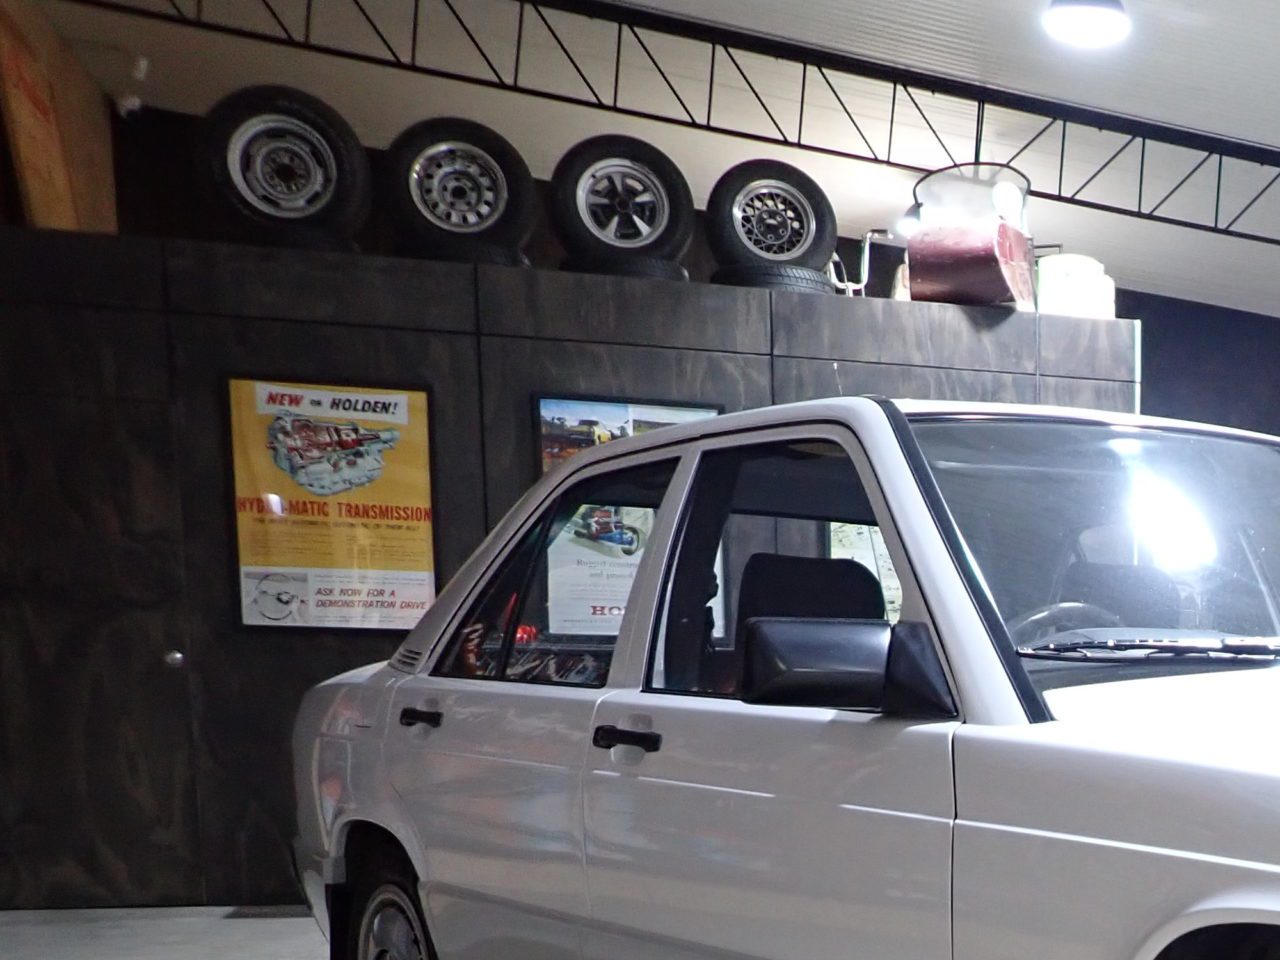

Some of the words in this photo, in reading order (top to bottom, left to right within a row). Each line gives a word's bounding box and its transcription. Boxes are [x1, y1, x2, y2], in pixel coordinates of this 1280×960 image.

[265, 392, 304, 407] NEW
[330, 397, 398, 415] HOLDEN!
[236, 496, 330, 517] HYD-MATIC
[337, 502, 432, 522] TRANSMISSION
[315, 587, 335, 597] ASK
[339, 588, 363, 597] NOW
[367, 588, 386, 598] FOR
[389, 590, 397, 598] A
[315, 599, 397, 609] DEMONSTRATION
[399, 601, 427, 609] DRIVE
